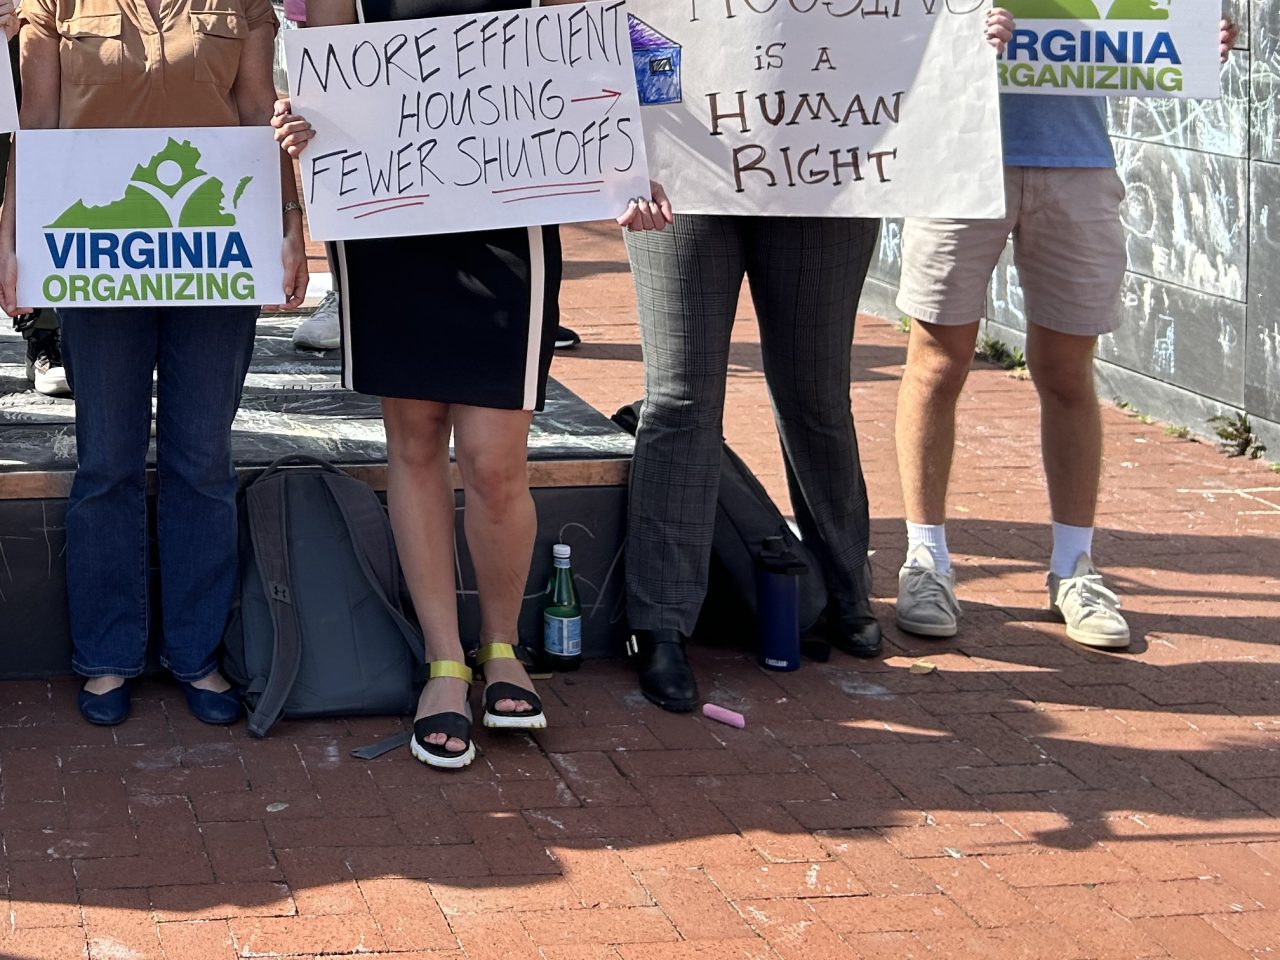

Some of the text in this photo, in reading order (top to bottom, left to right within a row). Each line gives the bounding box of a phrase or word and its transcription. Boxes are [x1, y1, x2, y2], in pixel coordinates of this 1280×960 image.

[297, 0, 627, 97] MORE EFFICIENT
[811, 47, 837, 71] A
[996, 28, 1182, 65] RGINIA
[997, 63, 1183, 92] RGANIZING
[398, 78, 565, 138] HOUSING
[705, 90, 905, 136] HUMAN
[310, 117, 635, 204] FEWER SHUTOFFS
[733, 144, 898, 193] RIGHT
[44, 231, 253, 269] VIRGINIA
[42, 271, 255, 303] ORGANIZING
